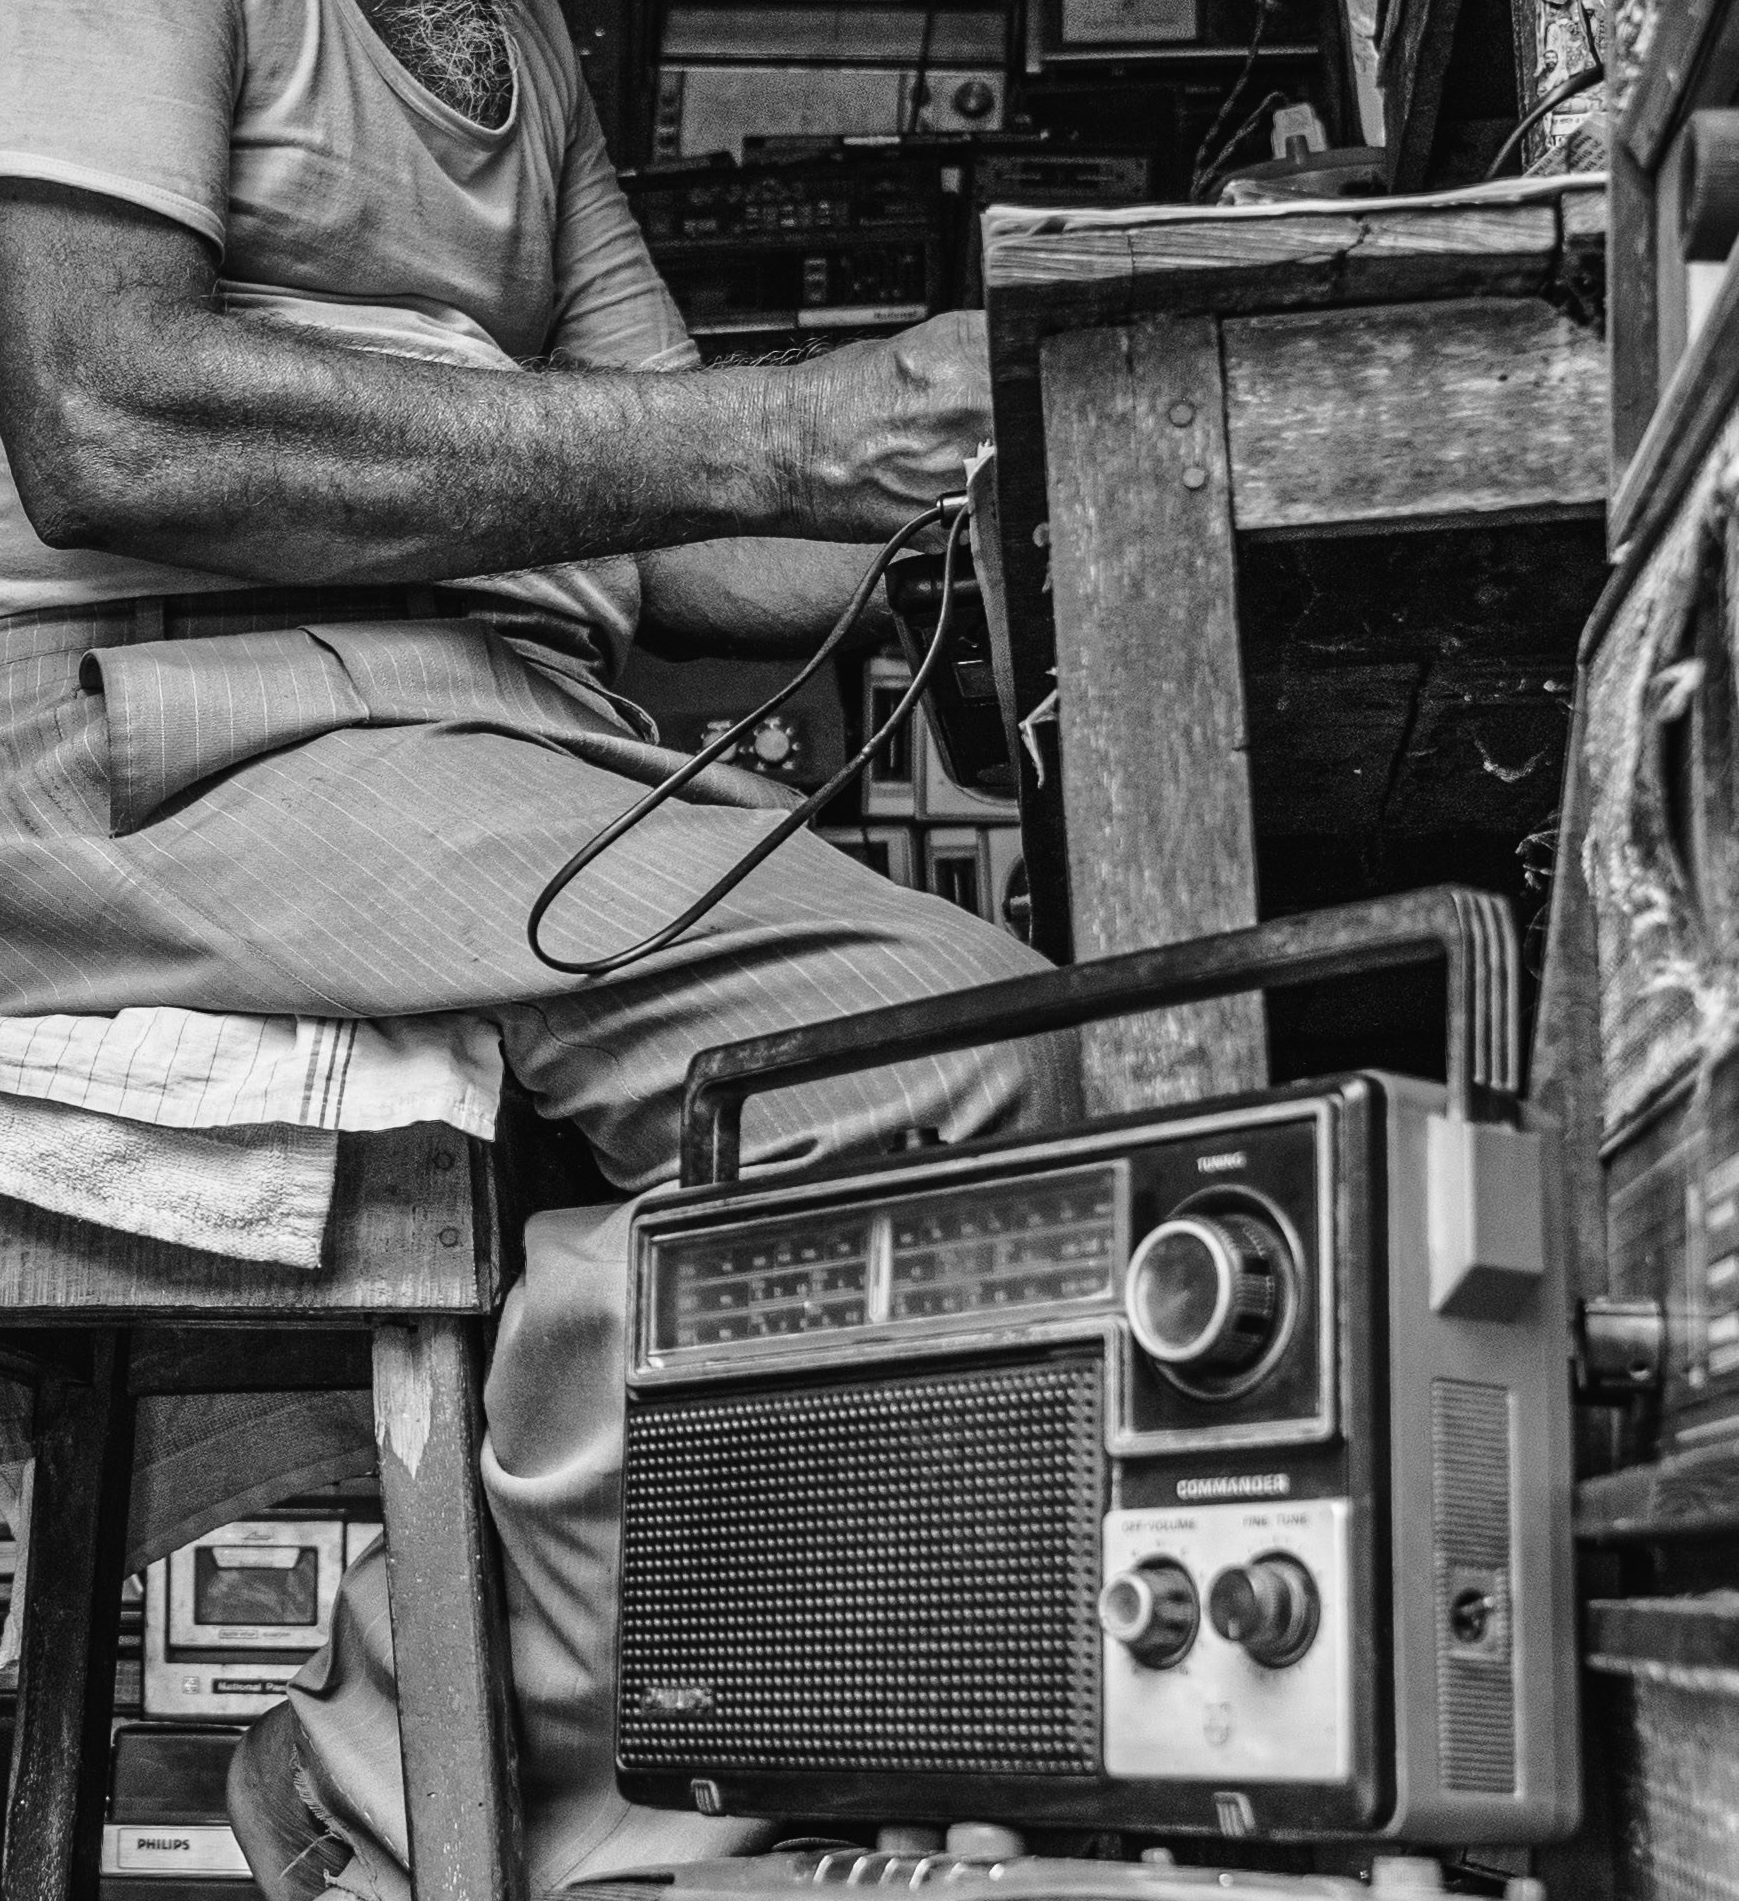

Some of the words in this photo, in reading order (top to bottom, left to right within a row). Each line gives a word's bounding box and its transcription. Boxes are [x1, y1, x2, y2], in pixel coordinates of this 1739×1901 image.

[1175, 1472, 1291, 1501] COMMANDER
[217, 1680, 262, 1692] National
[137, 1837, 191, 1851] PHILIPS
